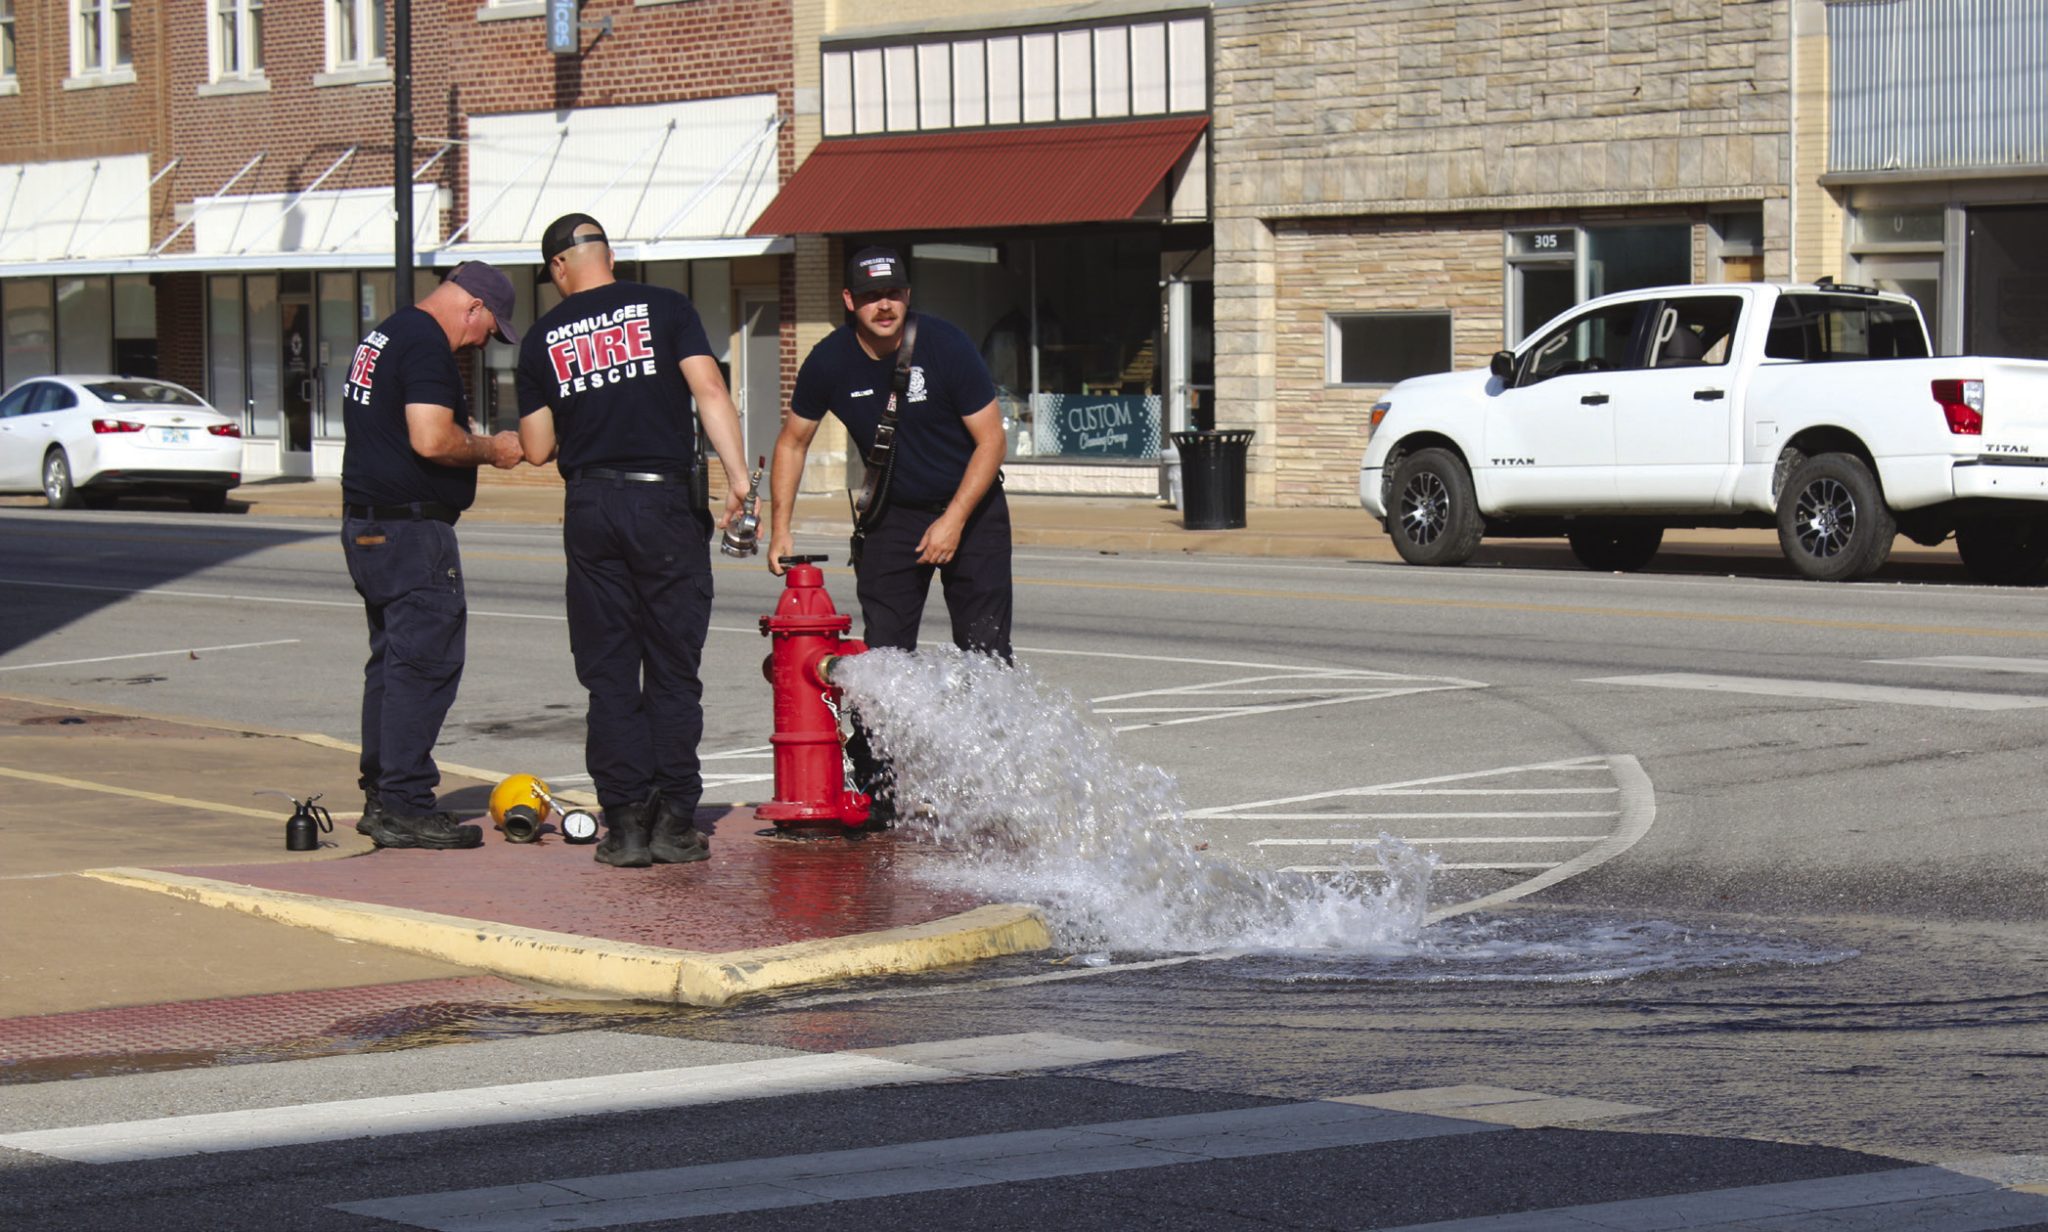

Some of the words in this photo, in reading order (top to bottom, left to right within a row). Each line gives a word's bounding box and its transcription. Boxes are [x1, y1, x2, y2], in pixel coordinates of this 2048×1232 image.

[554, 0, 574, 47] ices
[1534, 234, 1558, 249] 305
[546, 303, 649, 345] OKMULGEE
[548, 318, 655, 385] FIRE
[560, 360, 657, 398] RESCUE
[1068, 401, 1133, 433] CUSTOM
[1491, 458, 1535, 466] TITAN
[1985, 444, 2029, 453] TITAN
